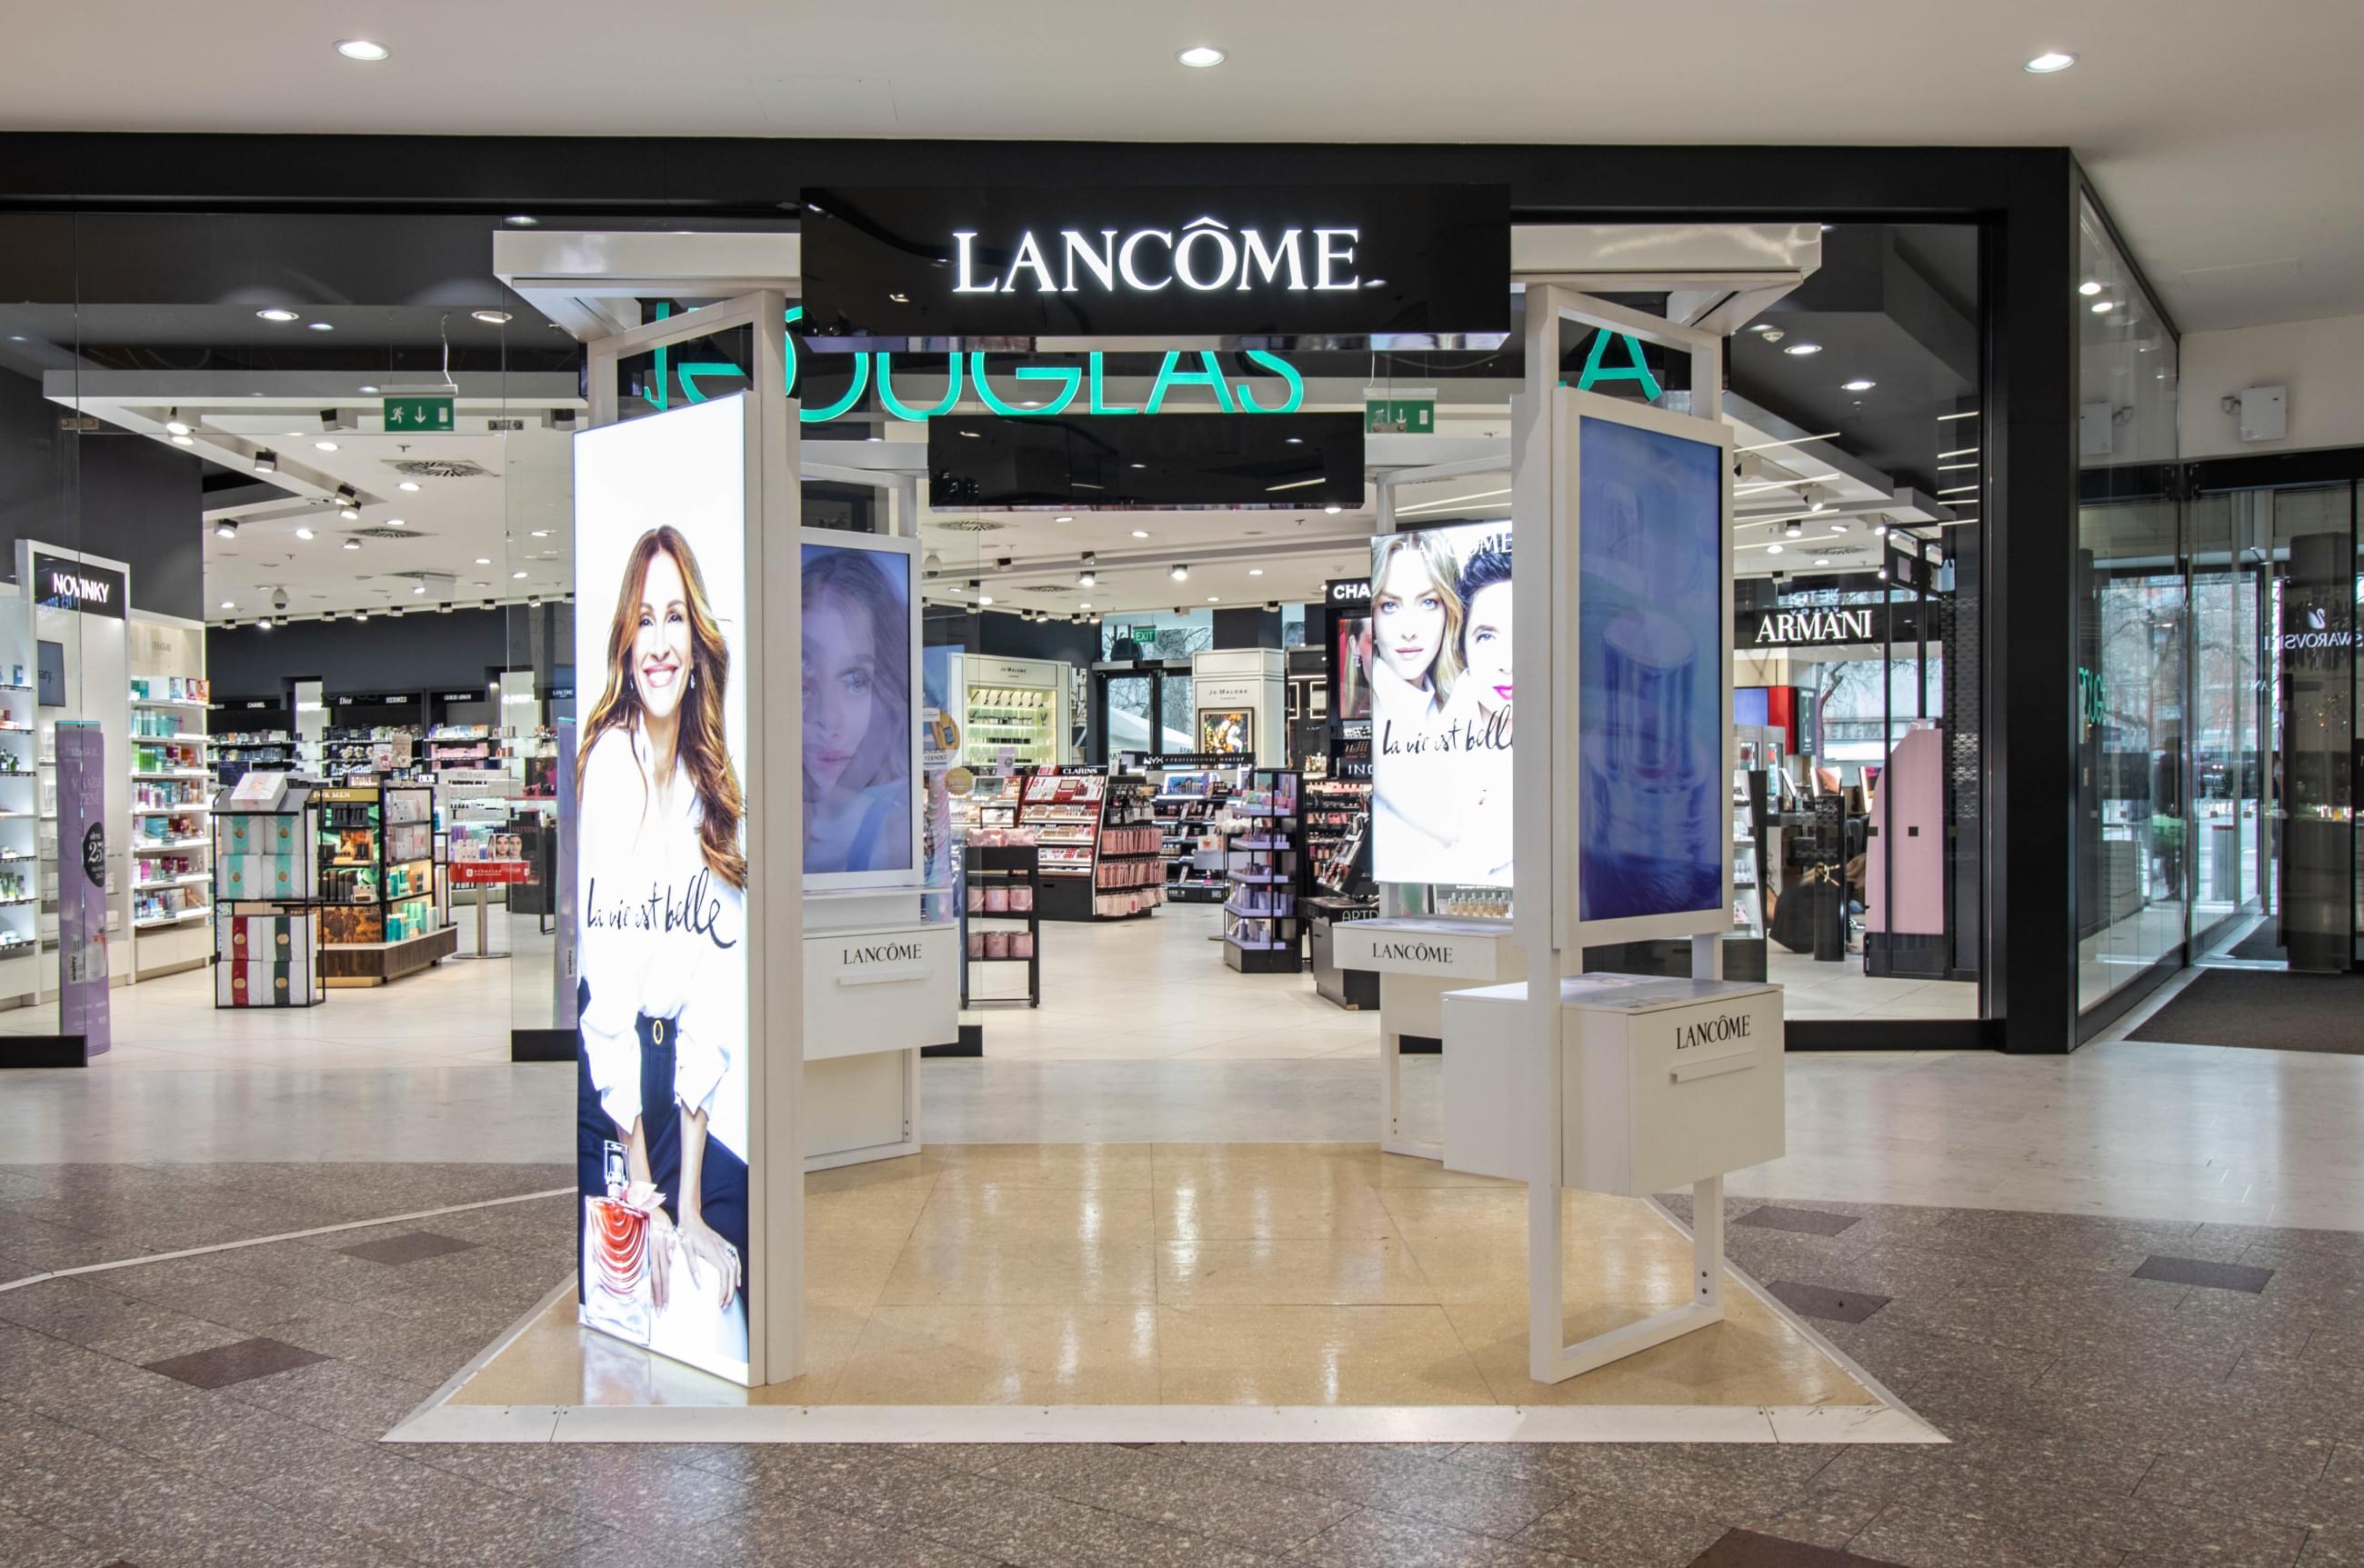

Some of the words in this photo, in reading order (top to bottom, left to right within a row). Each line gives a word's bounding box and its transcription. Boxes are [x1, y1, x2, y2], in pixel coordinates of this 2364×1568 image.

[952, 216, 1358, 293] LANCÔME
[53, 572, 109, 604] NOVINKY
[1136, 632, 1153, 641] EXIT
[1755, 610, 1872, 643] ARMANI
[1466, 704, 1513, 753] bell
[587, 877, 604, 928] La
[609, 899, 630, 930] vie
[666, 866, 736, 949] belle
[843, 943, 922, 965] LANCÔME
[1372, 942, 1454, 964] LANCÔME
[1676, 1014, 1750, 1050] LANCÔME
